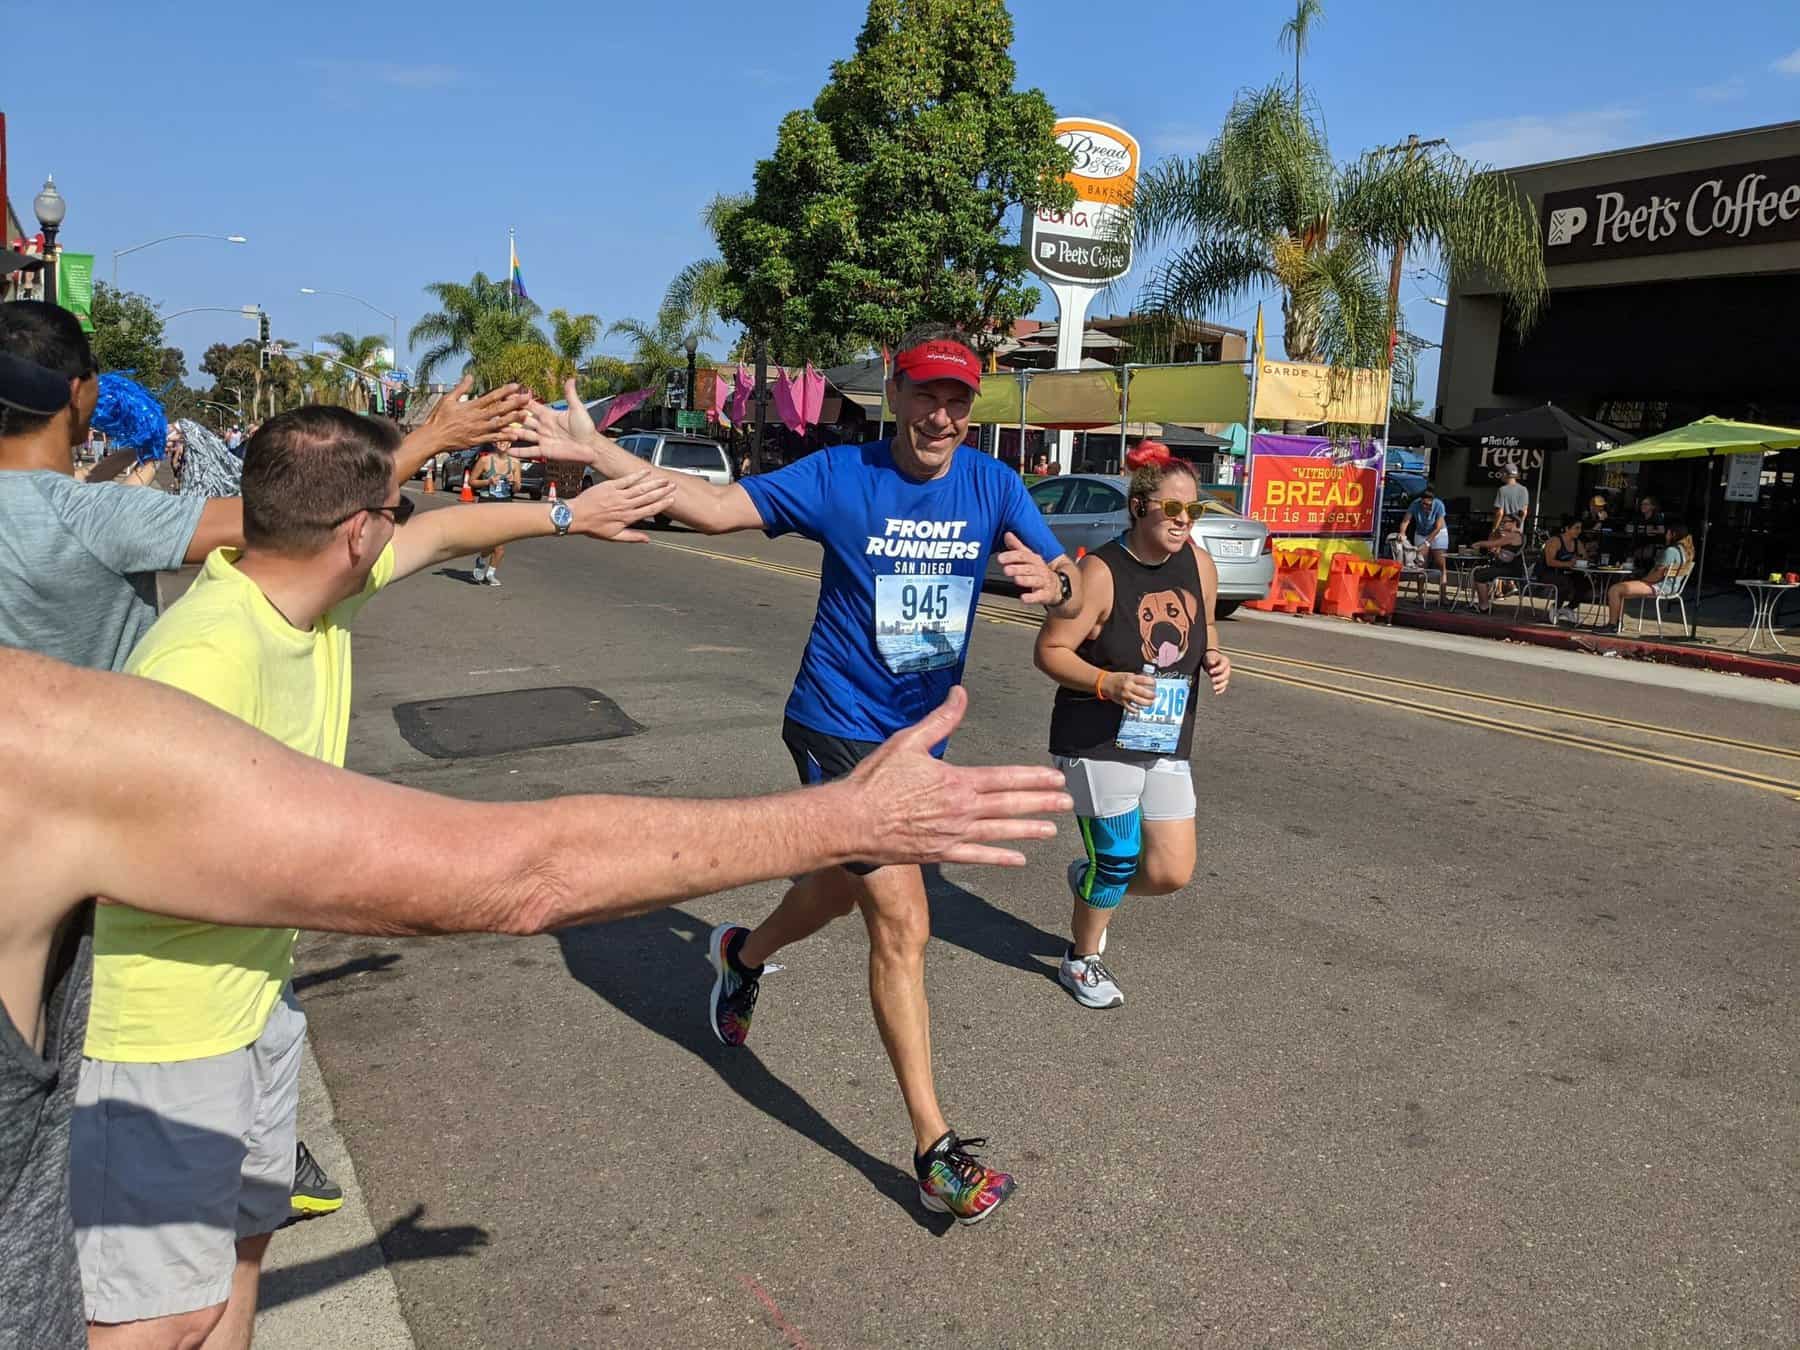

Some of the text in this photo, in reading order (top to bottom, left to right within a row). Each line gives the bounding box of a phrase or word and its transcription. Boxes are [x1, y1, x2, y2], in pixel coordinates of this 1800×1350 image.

[1066, 132, 1130, 169] Bread
[1088, 157, 1125, 176] & Cie
[1591, 172, 1800, 247] Peet's Coffee
[1058, 240, 1125, 269] Peet's Coffee
[1263, 364, 1309, 378] GARDE
[1266, 480, 1364, 507] BREAD
[884, 518, 968, 539] FRONT
[1251, 507, 1373, 527] all is misery."
[865, 536, 981, 560] RUNNERS
[894, 561, 952, 575] SAN DIEGO
[902, 584, 950, 620] 945
